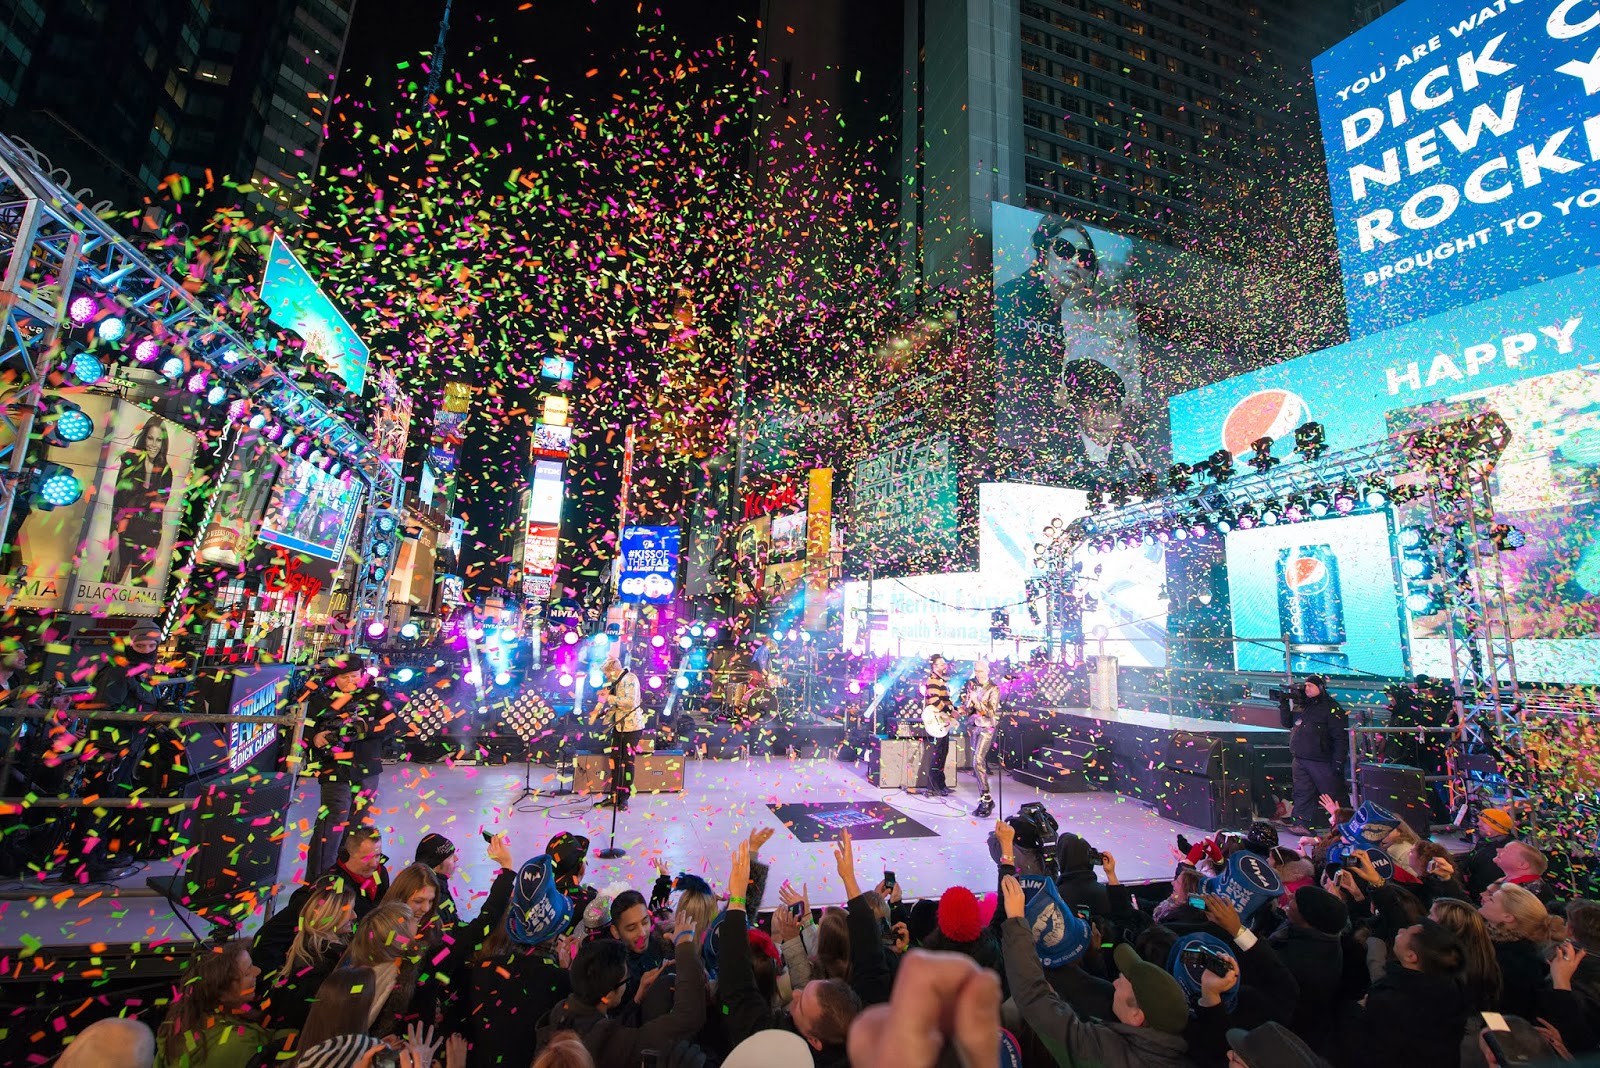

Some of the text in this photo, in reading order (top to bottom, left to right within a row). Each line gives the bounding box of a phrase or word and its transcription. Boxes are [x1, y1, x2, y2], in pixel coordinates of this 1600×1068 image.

[1336, 0, 1524, 101] YOU ARE WAT
[1341, 31, 1518, 152] DICK
[1349, 85, 1524, 201] NEW
[1363, 228, 1491, 286] BROUGHT
[1500, 211, 1542, 237] TO
[1018, 316, 1057, 337] DOLCE
[1386, 316, 1583, 396] HAPPY
[533, 448, 568, 459] TOSHIBA
[543, 467, 560, 476] TDK
[77, 584, 158, 604] BLACKGLAMA
[551, 609, 579, 619] NIVEA
[237, 743, 254, 767] DICK
[255, 727, 277, 753] CLARK
[1248, 857, 1270, 888] NIVEA
[1371, 858, 1389, 869] IVEA
[1225, 885, 1249, 907] EVE
[1230, 878, 1254, 897] NEW
[531, 901, 553, 927] EVE
